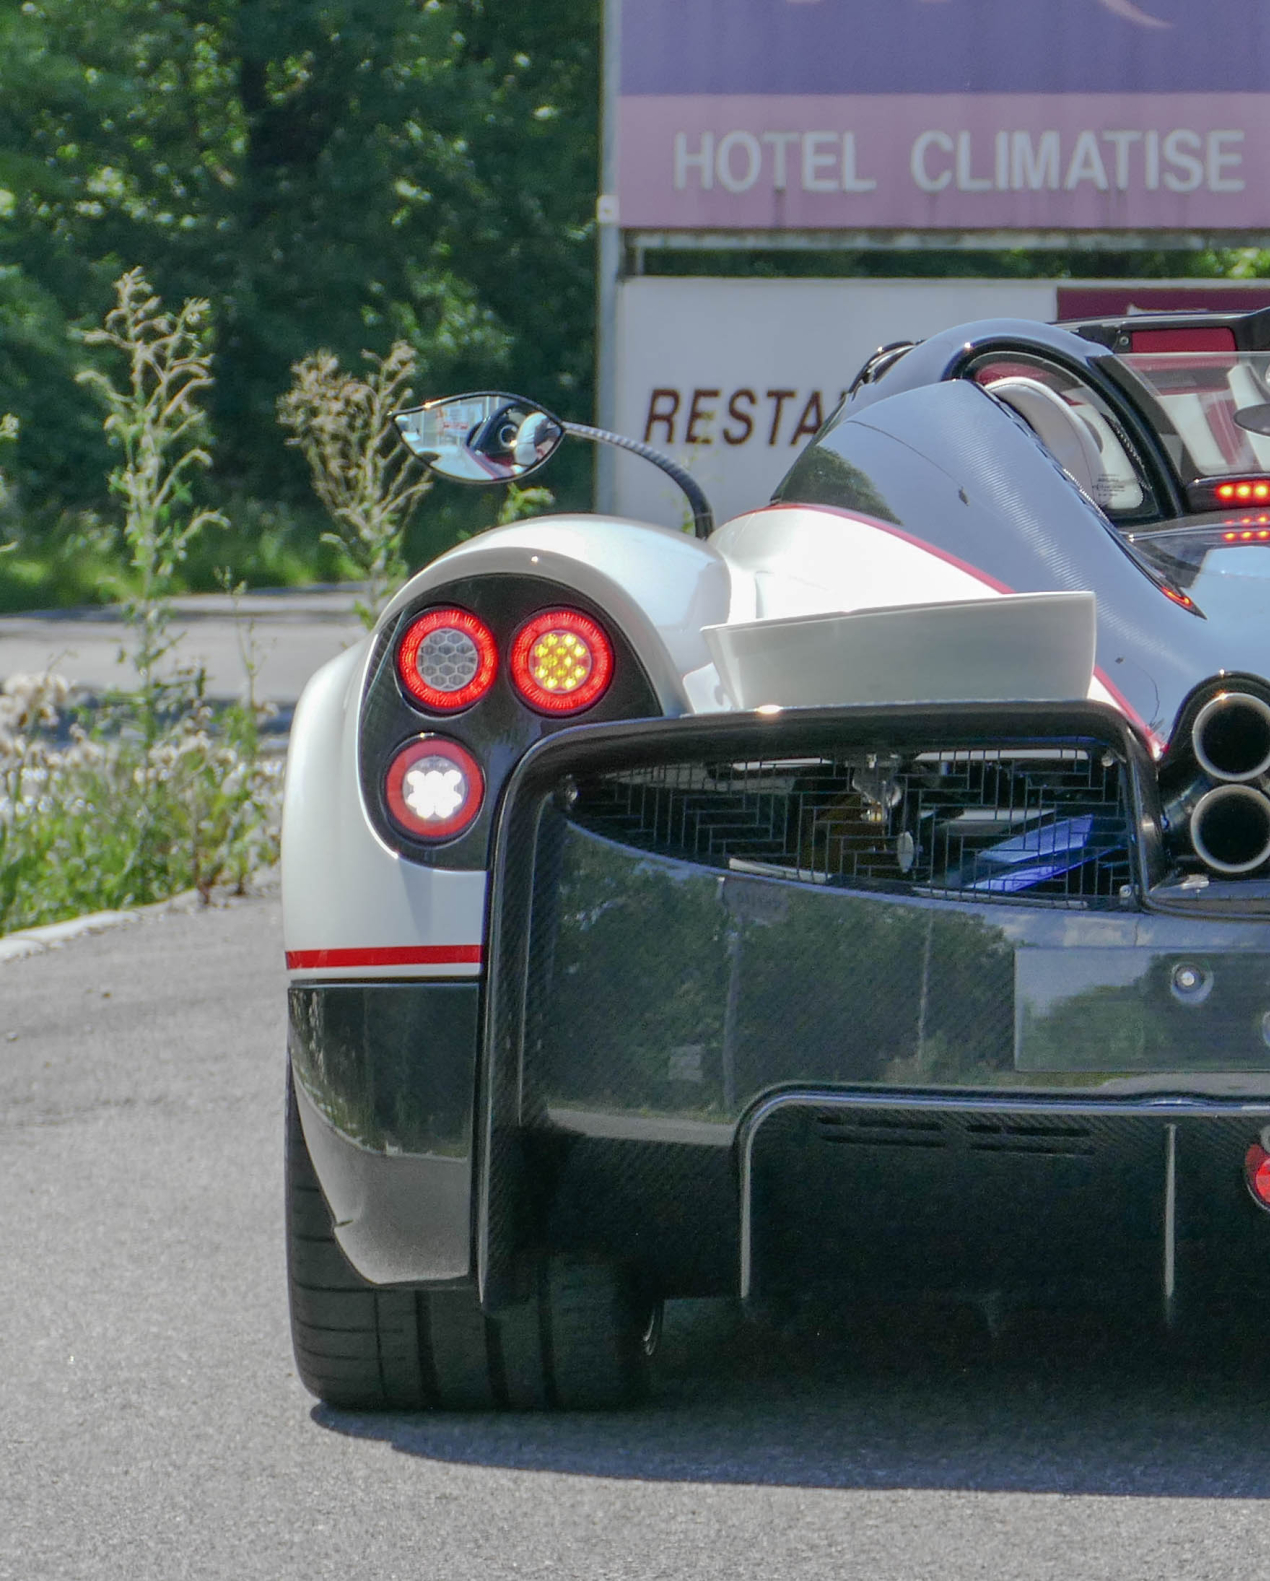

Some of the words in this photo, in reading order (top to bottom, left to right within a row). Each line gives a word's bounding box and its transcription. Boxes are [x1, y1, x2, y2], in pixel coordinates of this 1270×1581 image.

[674, 130, 877, 192] HOTEL
[910, 129, 1246, 192] CLIMATISE
[642, 387, 848, 447] RESTA
